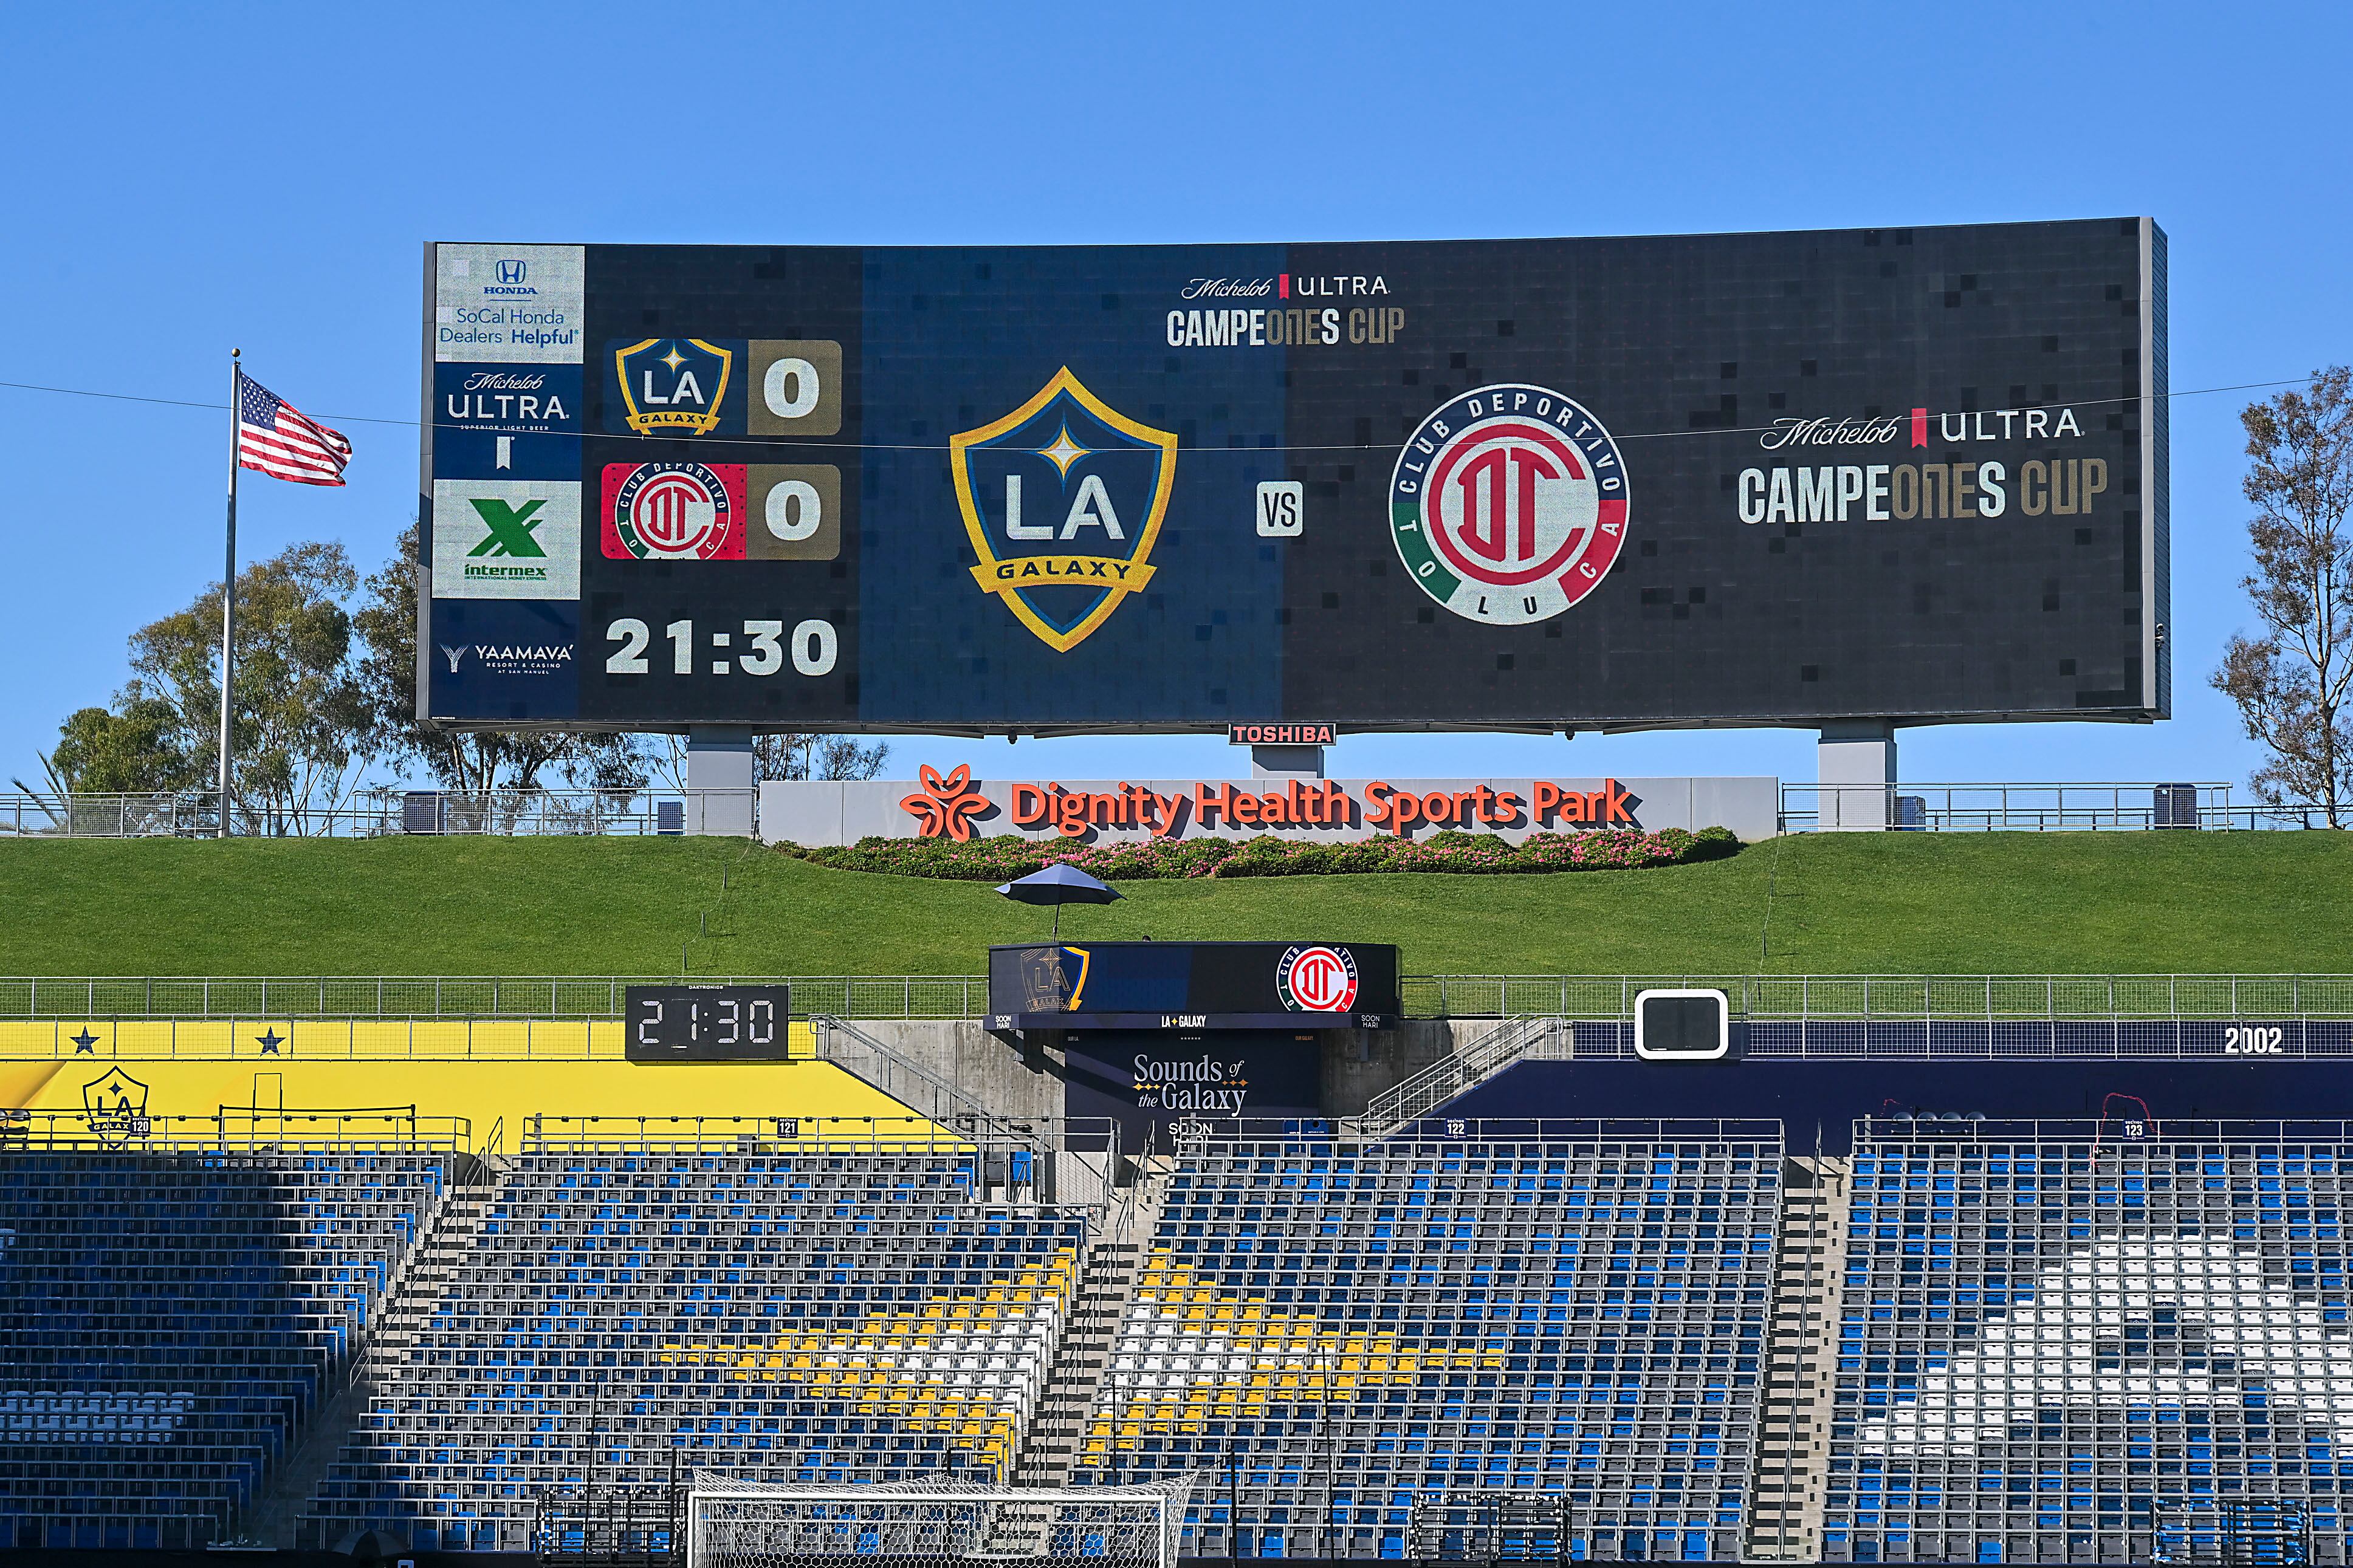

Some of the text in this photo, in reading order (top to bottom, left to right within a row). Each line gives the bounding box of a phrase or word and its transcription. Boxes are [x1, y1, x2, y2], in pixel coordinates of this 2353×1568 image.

[1181, 275, 1389, 300] Michelob ULTRA
[457, 308, 565, 324] SoCal Honda
[1166, 307, 1405, 347] CAMPEONES CUP
[440, 327, 503, 343] Dealers
[464, 372, 546, 390] Michelob
[644, 370, 705, 405] LA
[763, 357, 820, 419] 0
[448, 394, 566, 420] ULTRA
[639, 413, 708, 425] GALAXY
[1760, 408, 2082, 450] Michelob ULTRA
[1399, 392, 1621, 494] CLUB DEPORTIVO
[620, 463, 727, 508] CLUB DEPORTIVO
[1737, 457, 2108, 524] CAMPEONES CUP
[765, 480, 822, 541] 0
[1005, 474, 1125, 540] LA
[1263, 491, 1297, 527] VS
[464, 564, 547, 575] intermex
[996, 560, 1132, 580] GALAXY
[606, 618, 838, 676] 21:30
[1232, 726, 1331, 742] TOSHIBA
[1011, 778, 1633, 837] Dignity Health Sports Park
[1280, 947, 1300, 976] CLUB
[1035, 966, 1071, 992] LA
[639, 1000, 774, 1044] 21:30
[1161, 1015, 1206, 1027] LA GALAXY
[2225, 1027, 2283, 1053] 2002
[1134, 1054, 1245, 1081] Sounds of
[97, 1095, 134, 1117] LA
[1138, 1082, 1247, 1117] the Galaxy
[132, 1121, 149, 1132] 120
[779, 1122, 795, 1134] 121
[1447, 1123, 1465, 1134] 122
[2125, 1125, 2143, 1136] 123
